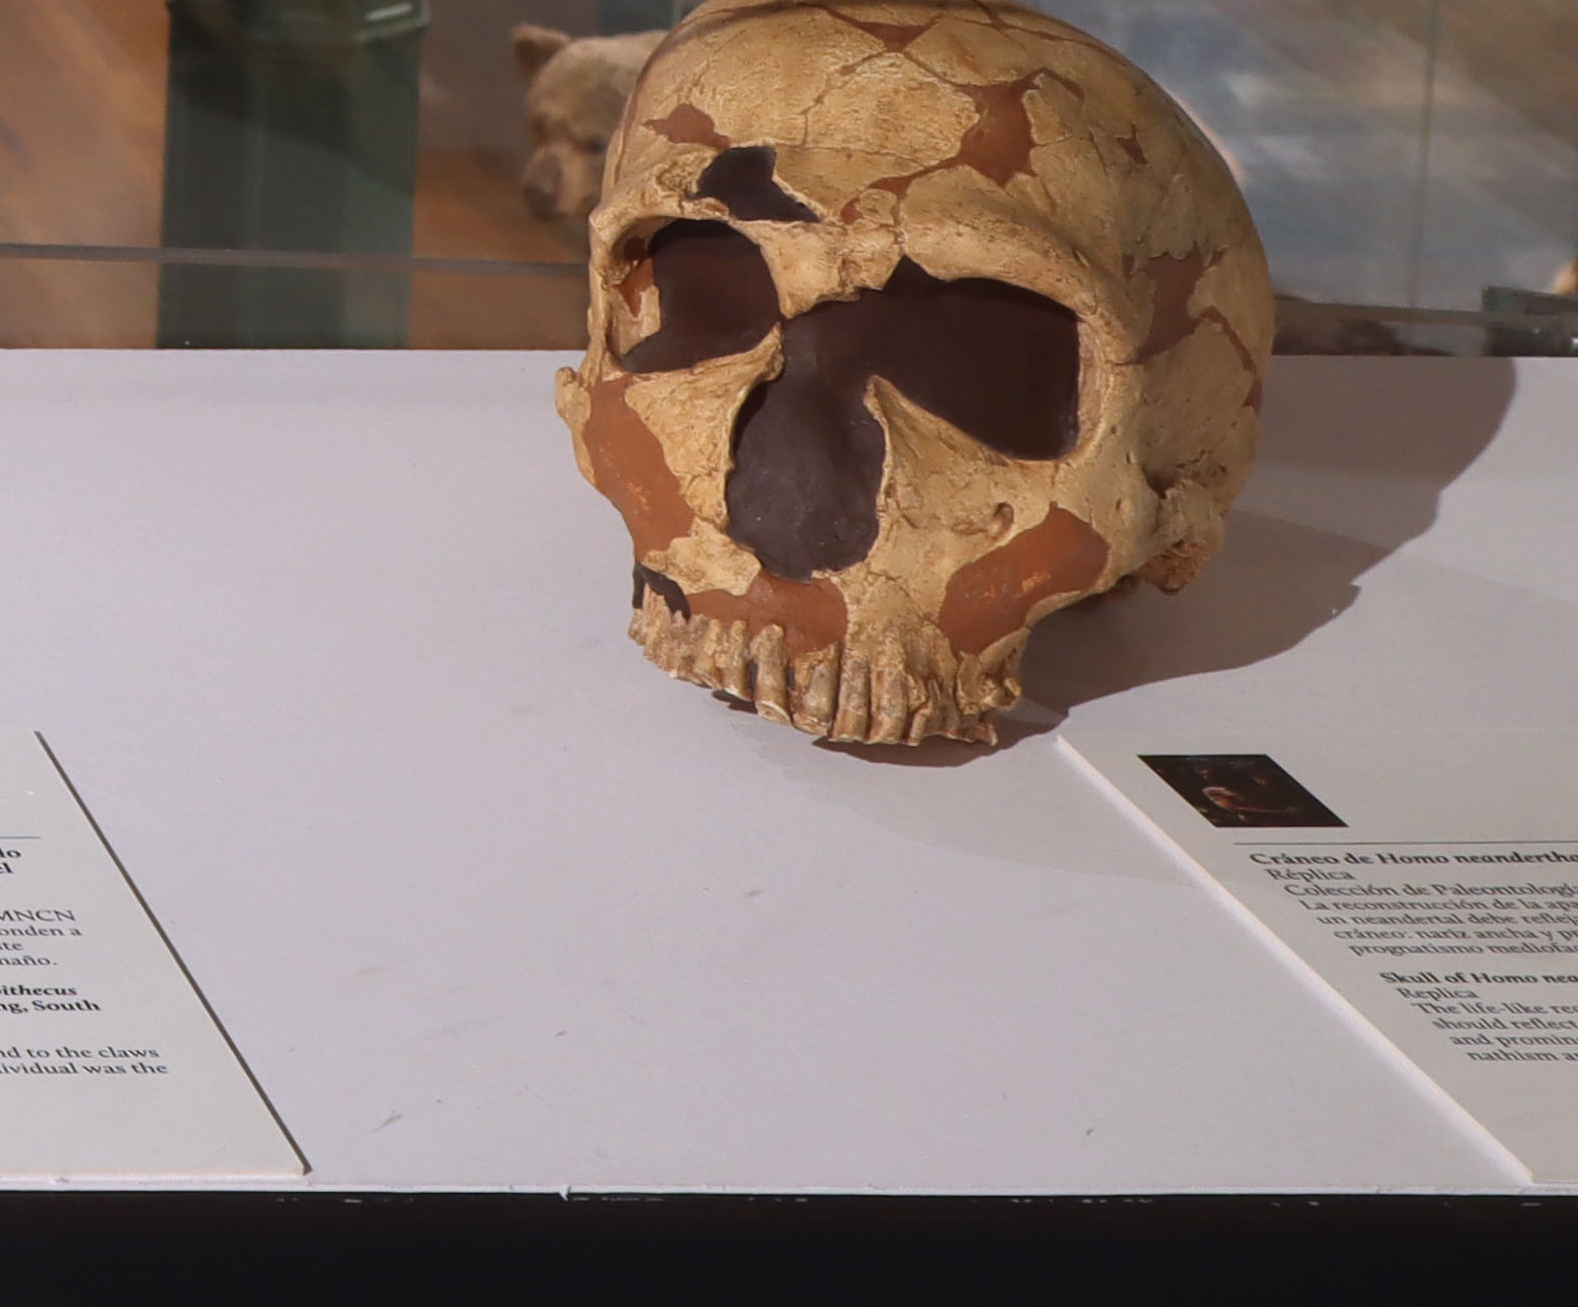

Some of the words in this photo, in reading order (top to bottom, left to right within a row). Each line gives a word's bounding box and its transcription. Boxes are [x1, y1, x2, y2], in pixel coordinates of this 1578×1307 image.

[1249, 853, 1339, 864] Cráneo
[1343, 852, 1373, 864] de
[1376, 852, 1449, 864] Homo
[1265, 869, 1354, 883] Réplica
[1284, 885, 1399, 896] Colección
[1401, 884, 1430, 896] de
[1316, 916, 1347, 925] un
[1351, 913, 1463, 925] neandertal
[1467, 913, 1517, 924] debe
[1379, 972, 1440, 983] Skull
[1443, 971, 1468, 983] of
[1470, 971, 1538, 983] Homo
[1396, 987, 1478, 1001] Replica
[31, 999, 100, 1011] South
[1411, 1003, 1459, 1014] The
[1464, 1003, 1546, 1014] life-like
[1432, 1018, 1508, 1030] should
